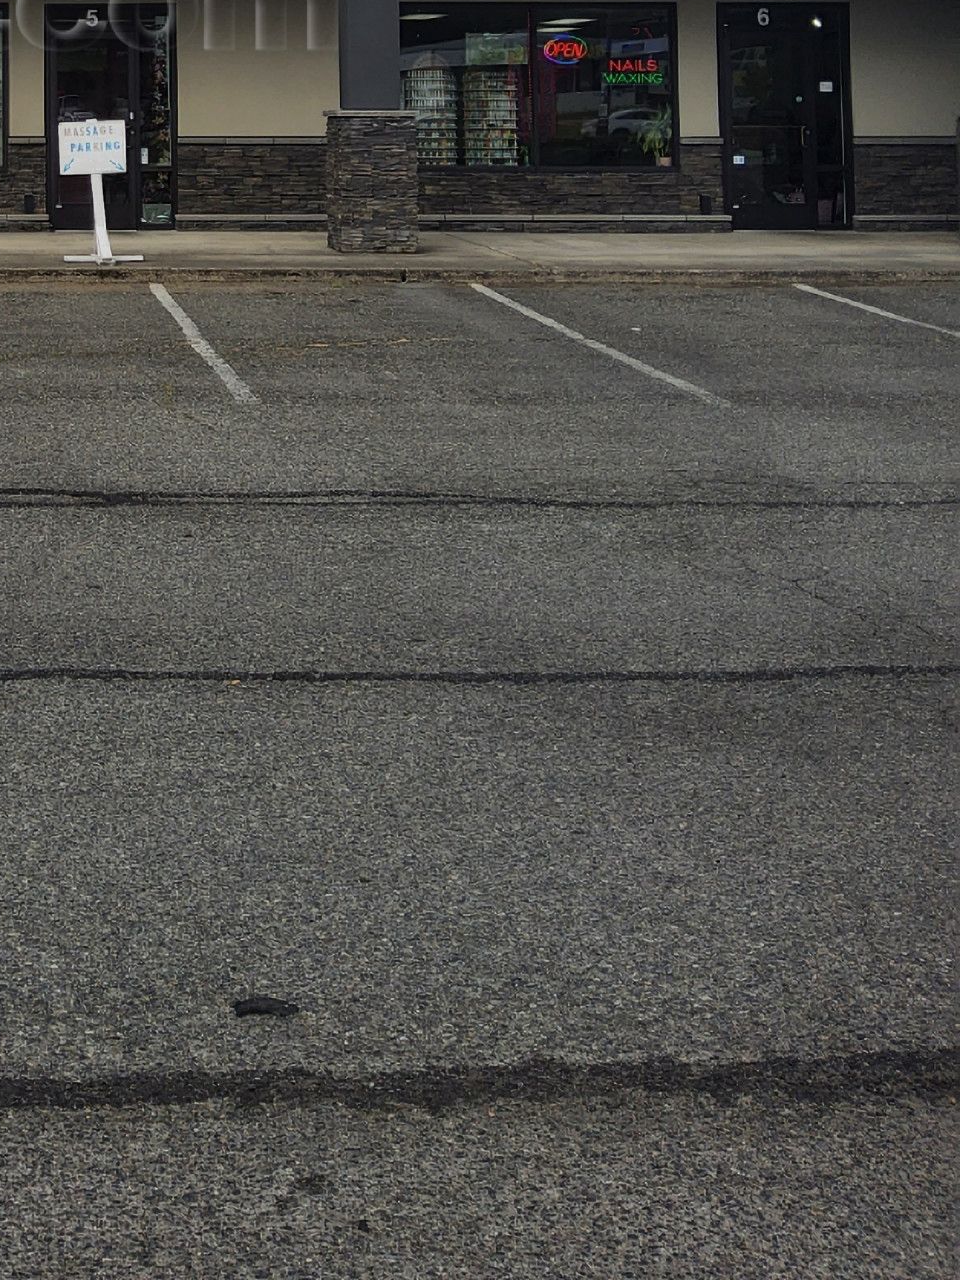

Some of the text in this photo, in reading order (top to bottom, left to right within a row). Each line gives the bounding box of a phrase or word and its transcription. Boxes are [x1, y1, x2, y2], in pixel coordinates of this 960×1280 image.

[86, 9, 98, 27] 5
[757, 8, 770, 26] 6
[545, 42, 583, 59] OPEN
[608, 60, 658, 71] NAILS
[603, 72, 663, 84] WAXING
[64, 126, 113, 137] MASSAGE
[70, 141, 120, 152] PARKING
